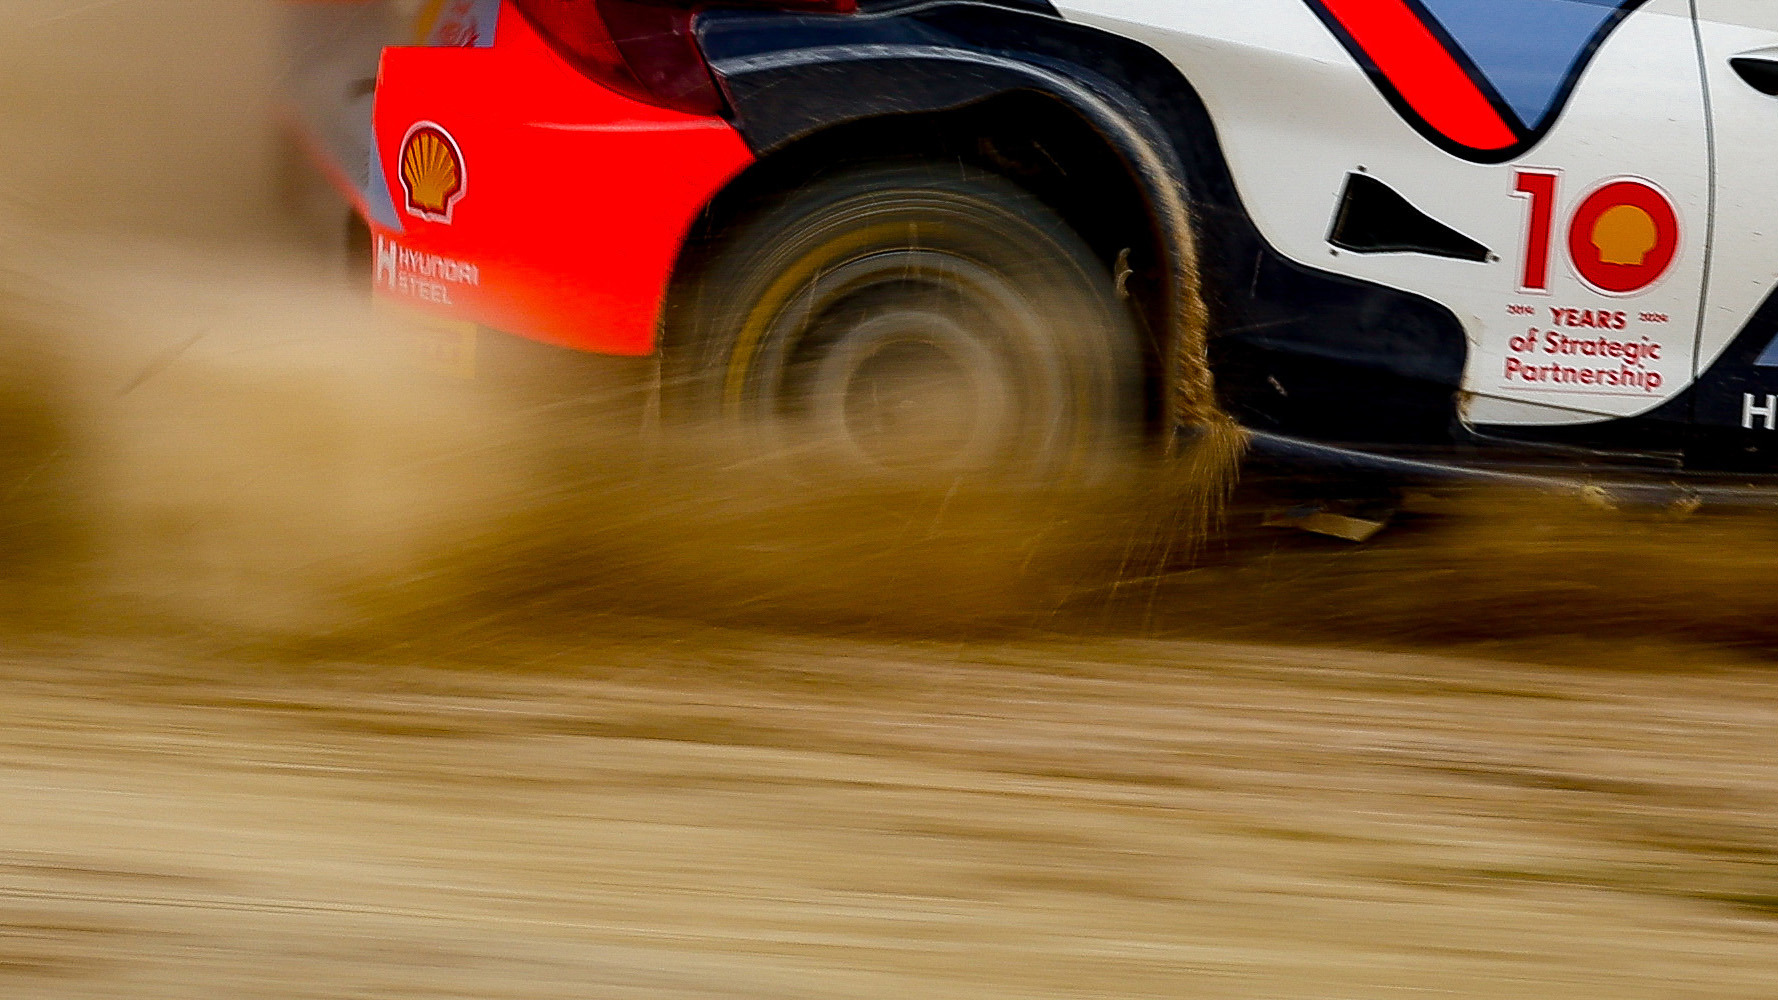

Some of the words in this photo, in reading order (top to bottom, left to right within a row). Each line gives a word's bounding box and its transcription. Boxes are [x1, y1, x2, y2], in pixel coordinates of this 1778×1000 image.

[399, 246, 479, 286] HYUNDAI
[399, 274, 452, 304] STEEL
[1550, 306, 1628, 330] YEARS
[1509, 327, 1538, 353] of
[1543, 330, 1662, 365] Strategic
[1504, 357, 1663, 392] Partnership
